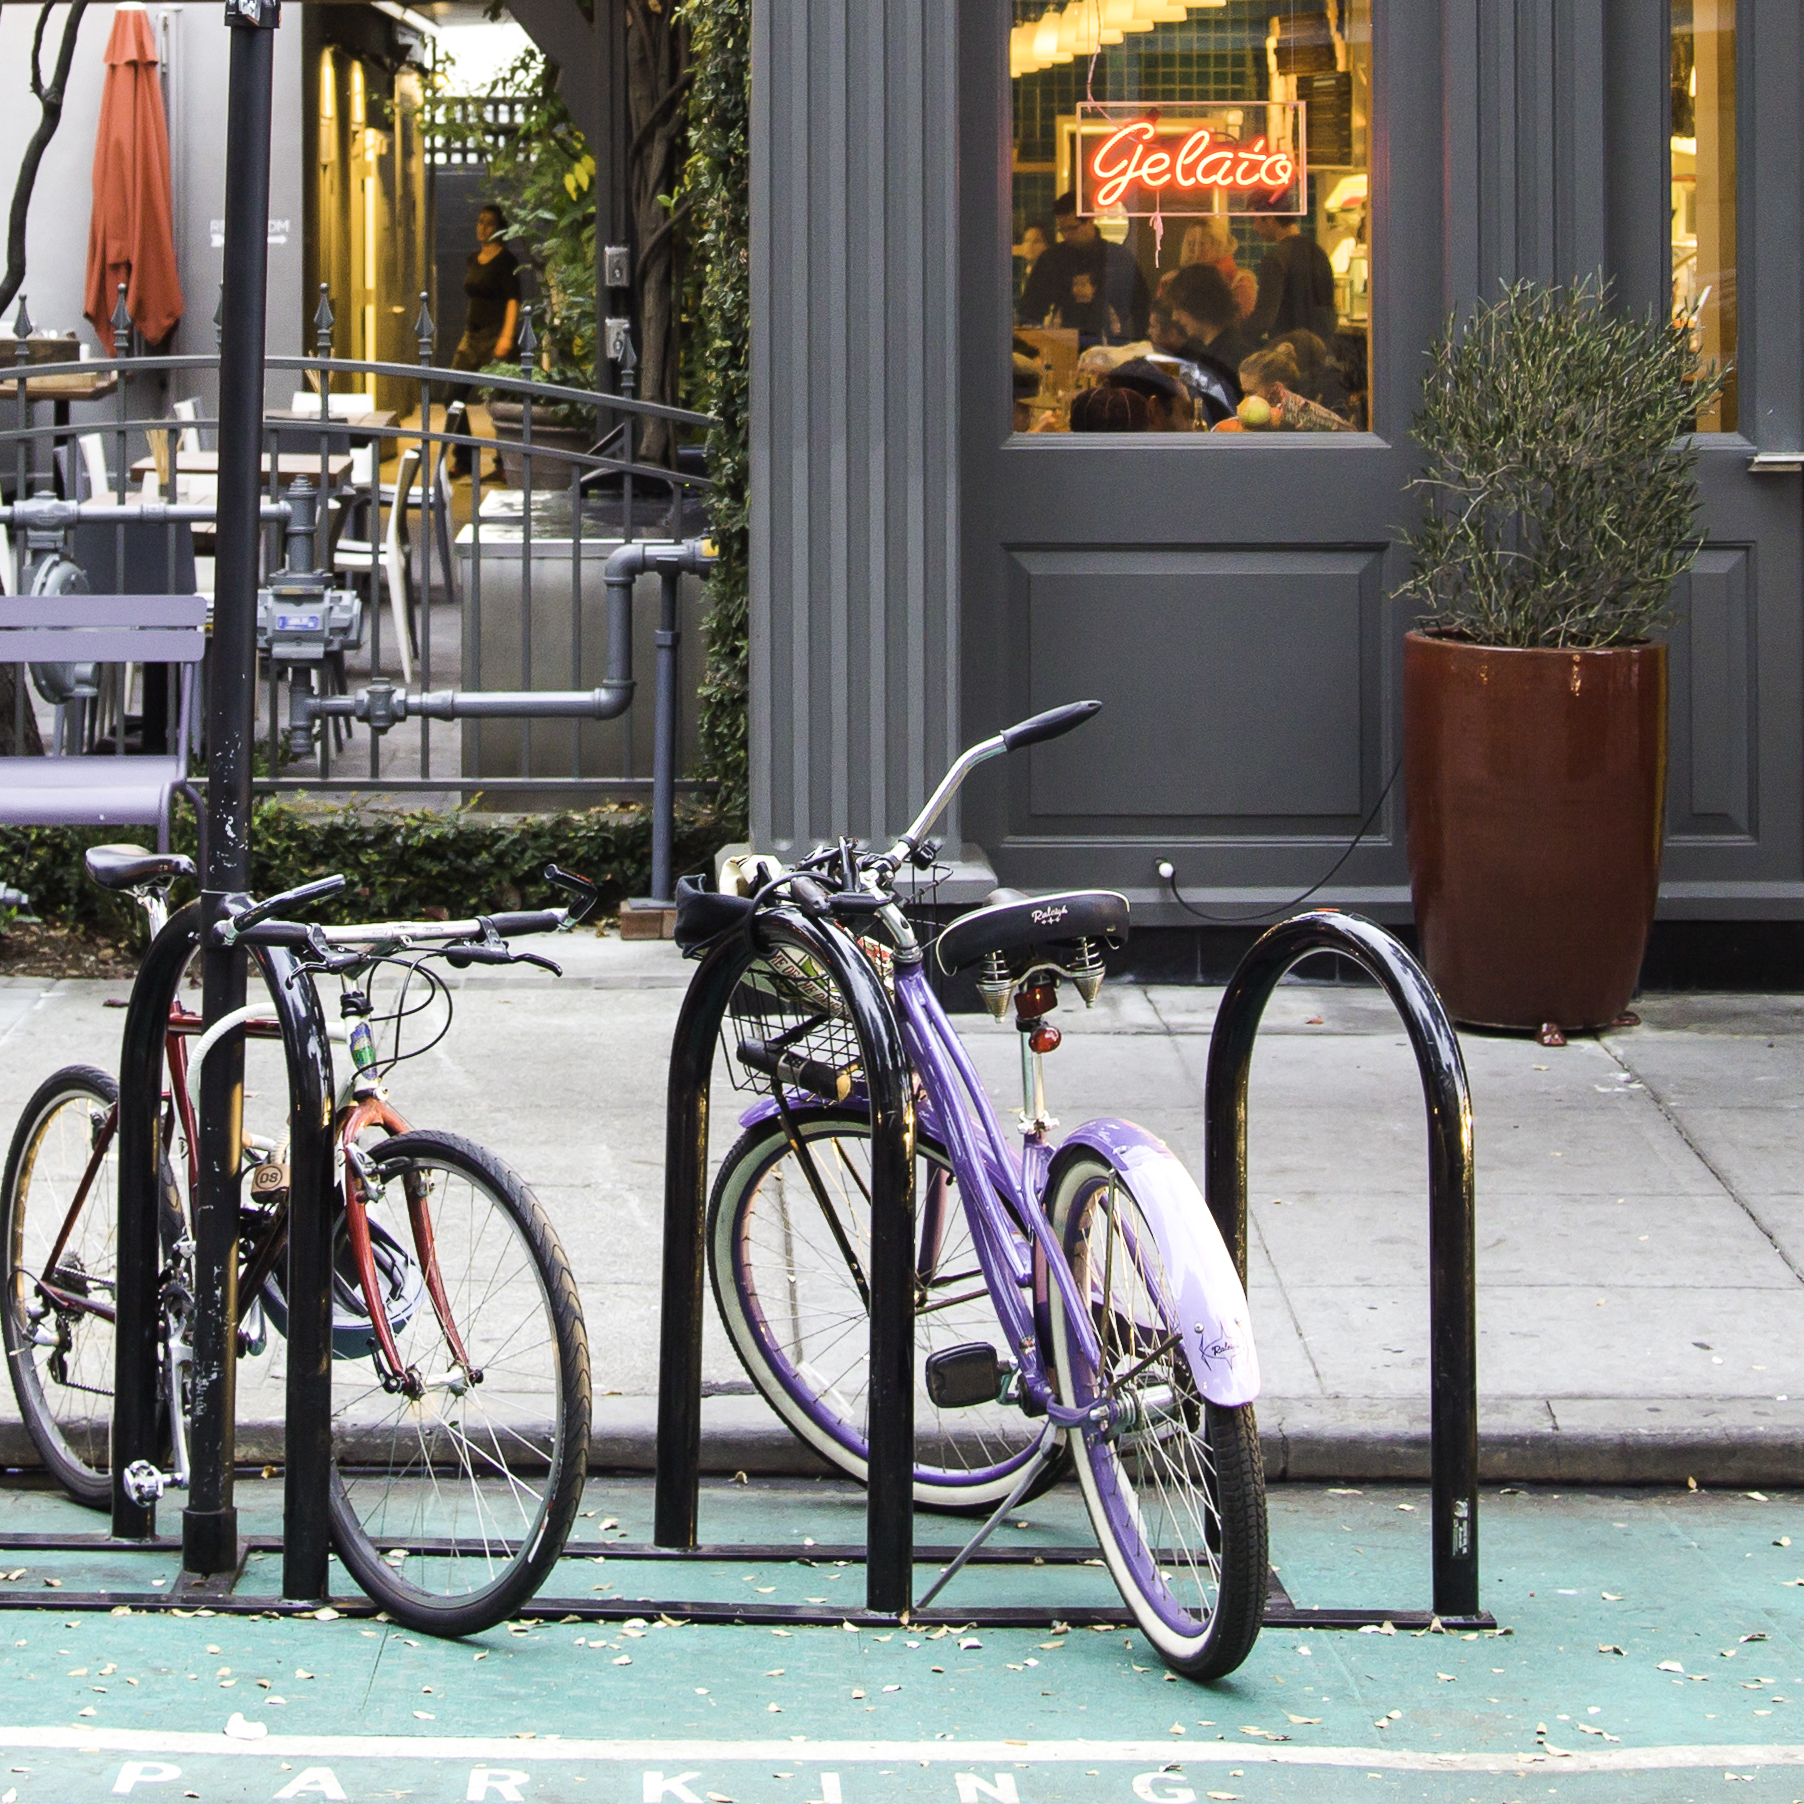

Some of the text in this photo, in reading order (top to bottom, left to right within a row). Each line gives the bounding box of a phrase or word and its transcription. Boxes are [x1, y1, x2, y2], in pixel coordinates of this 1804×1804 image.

[1093, 122, 1293, 206] Gelato
[1031, 904, 1068, 924] Raleigh
[260, 1172, 278, 1184] DS
[111, 1760, 1200, 1803] PARKING
